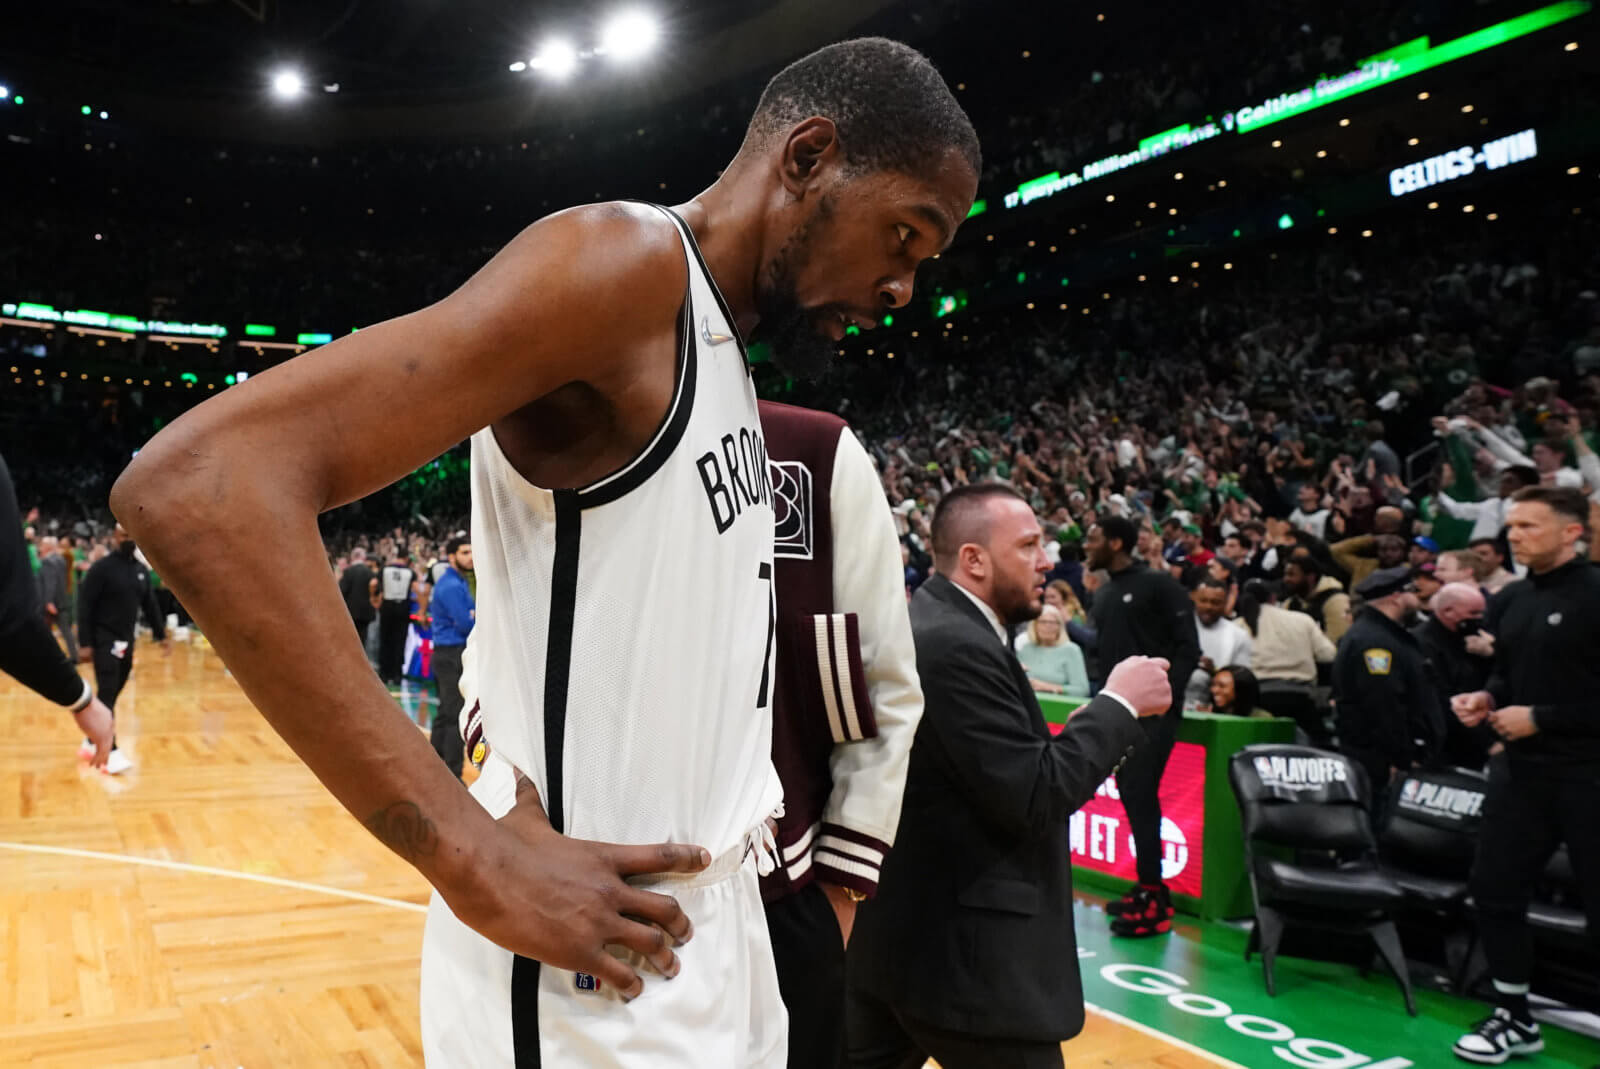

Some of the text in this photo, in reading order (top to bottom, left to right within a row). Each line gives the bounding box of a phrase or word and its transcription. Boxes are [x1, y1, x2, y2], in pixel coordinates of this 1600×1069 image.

[1235, 87, 1314, 126] Celtics
[757, 562, 775, 709] 7
[1270, 756, 1347, 784] PLAYOFFS
[579, 974, 588, 988] 75
